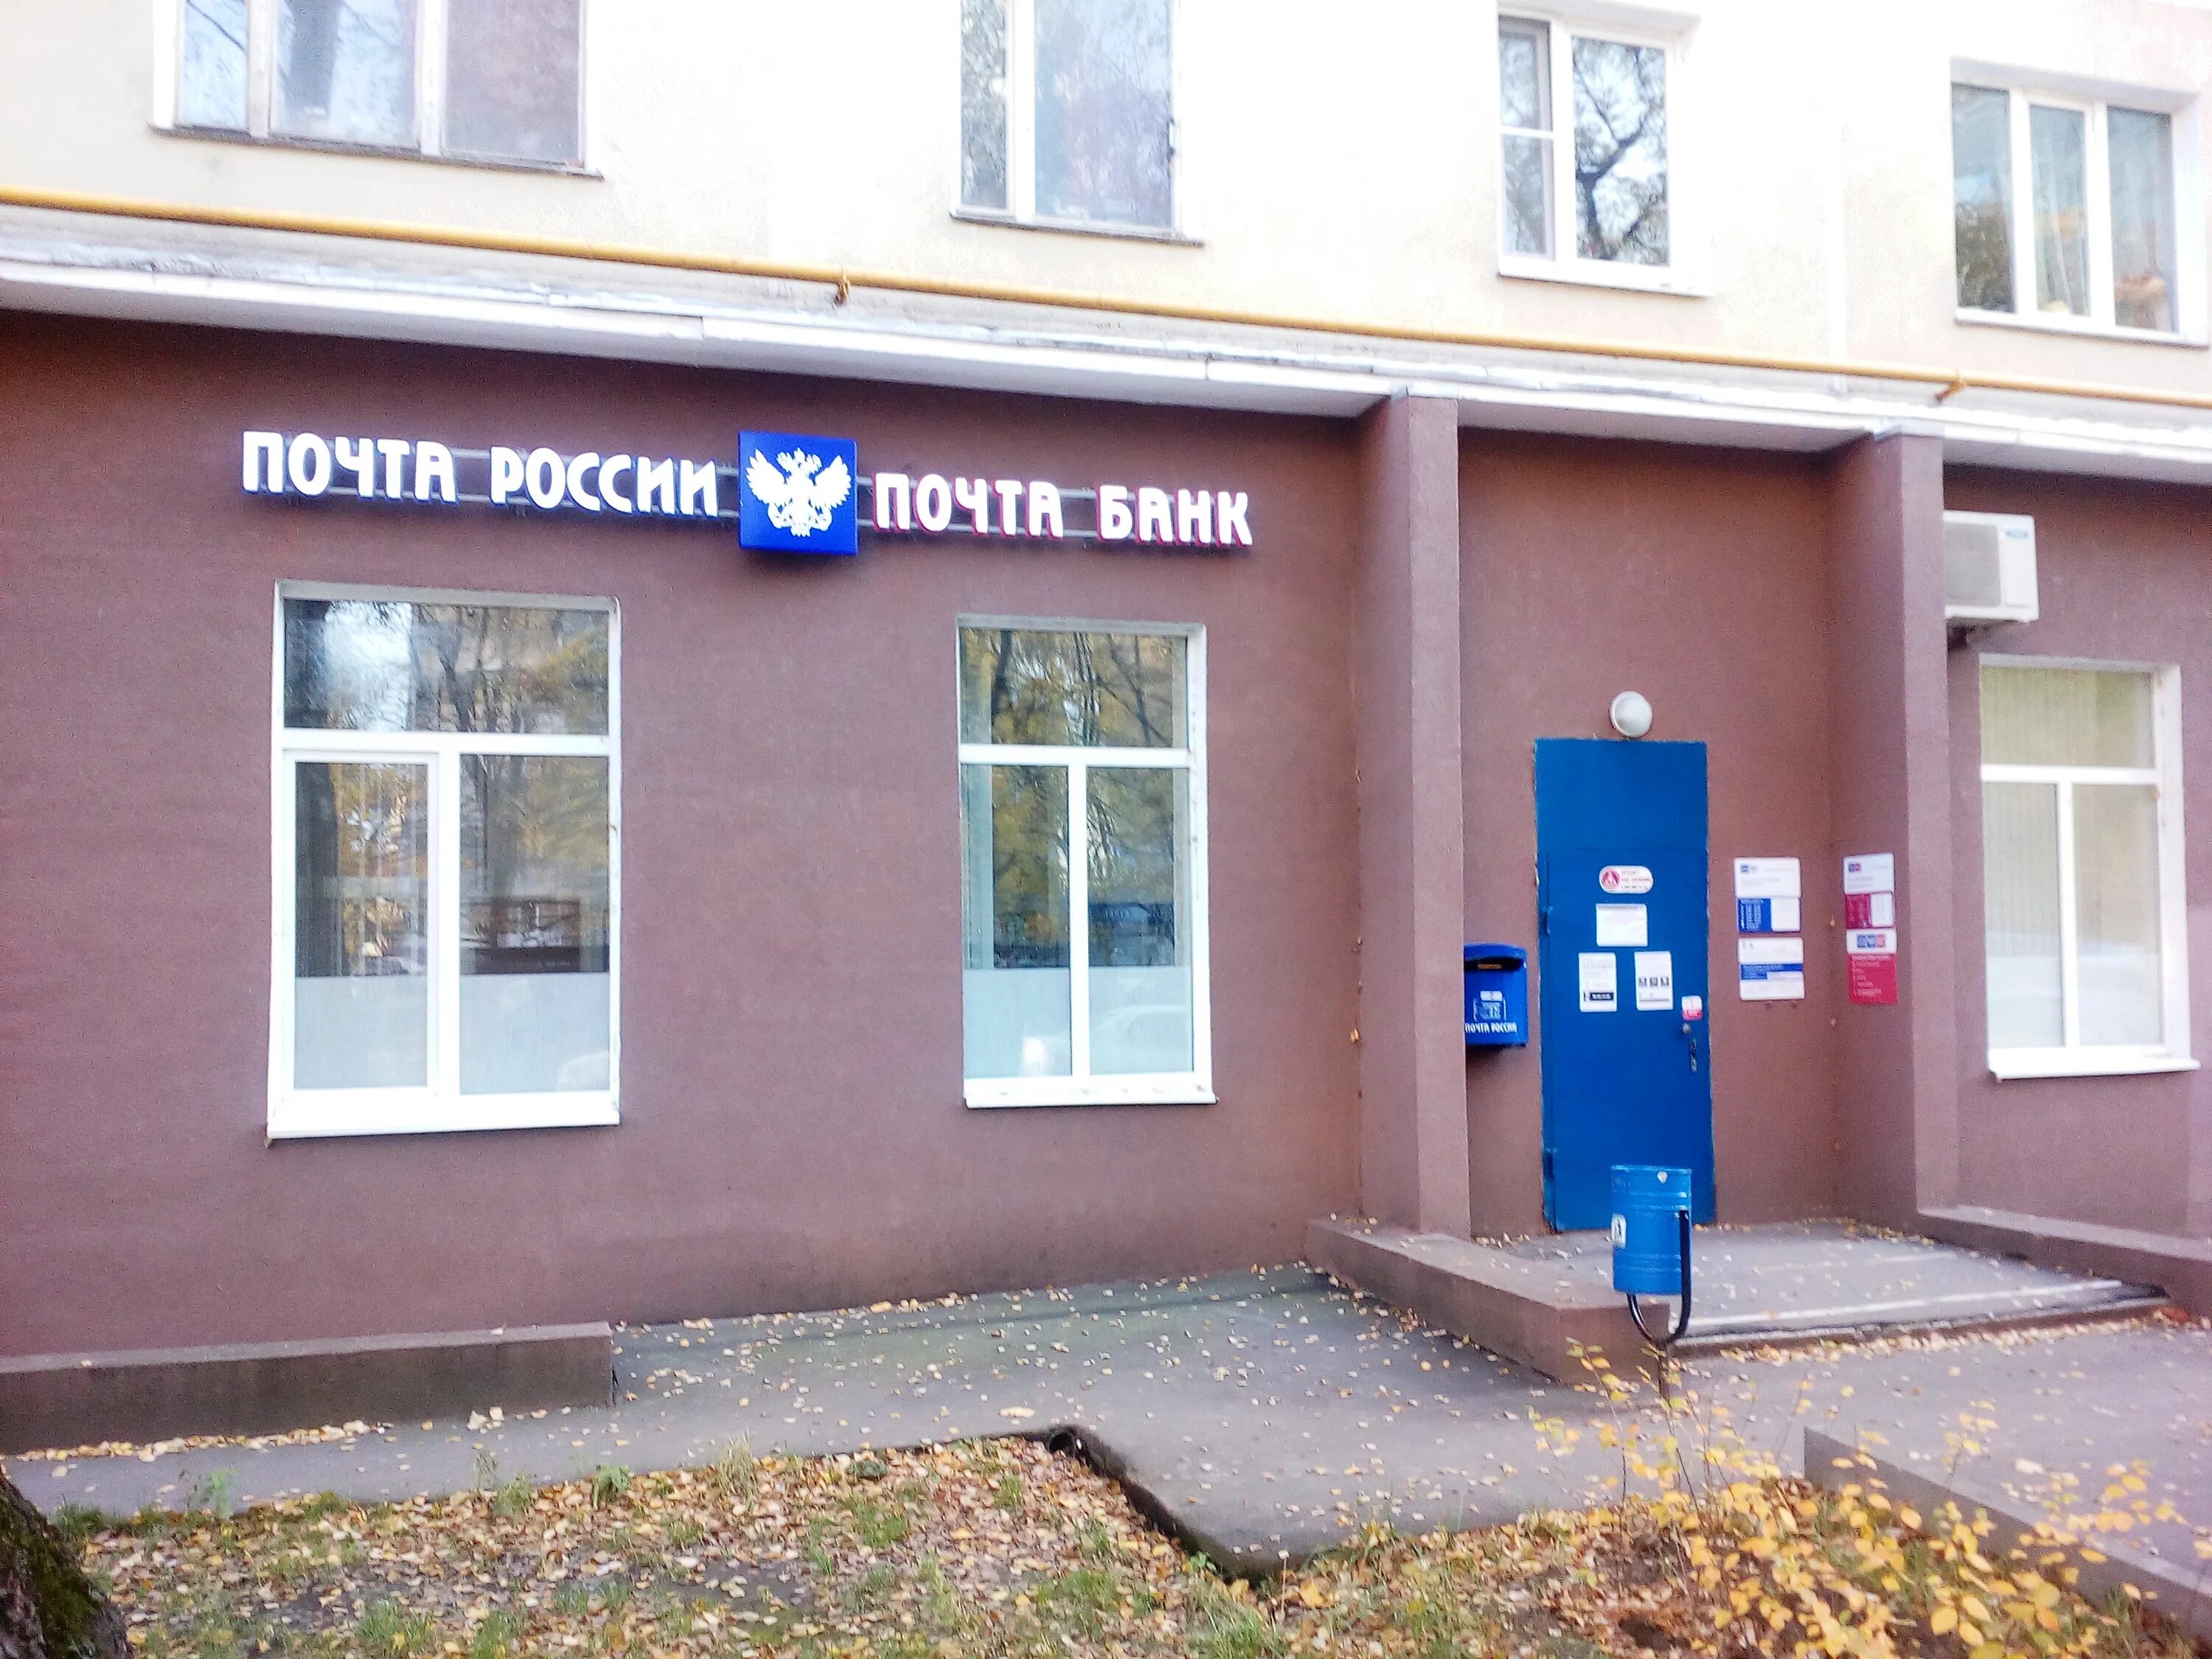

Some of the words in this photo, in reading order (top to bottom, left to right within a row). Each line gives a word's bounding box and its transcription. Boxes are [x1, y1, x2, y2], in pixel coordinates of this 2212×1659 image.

[242, 431, 459, 504] ПОЧТА
[490, 446, 721, 518] РОССИИ
[873, 472, 1064, 538] ПОЧТА
[1097, 485, 1253, 547] БАНК
[1464, 1022, 1490, 1033] ПОЧТА
